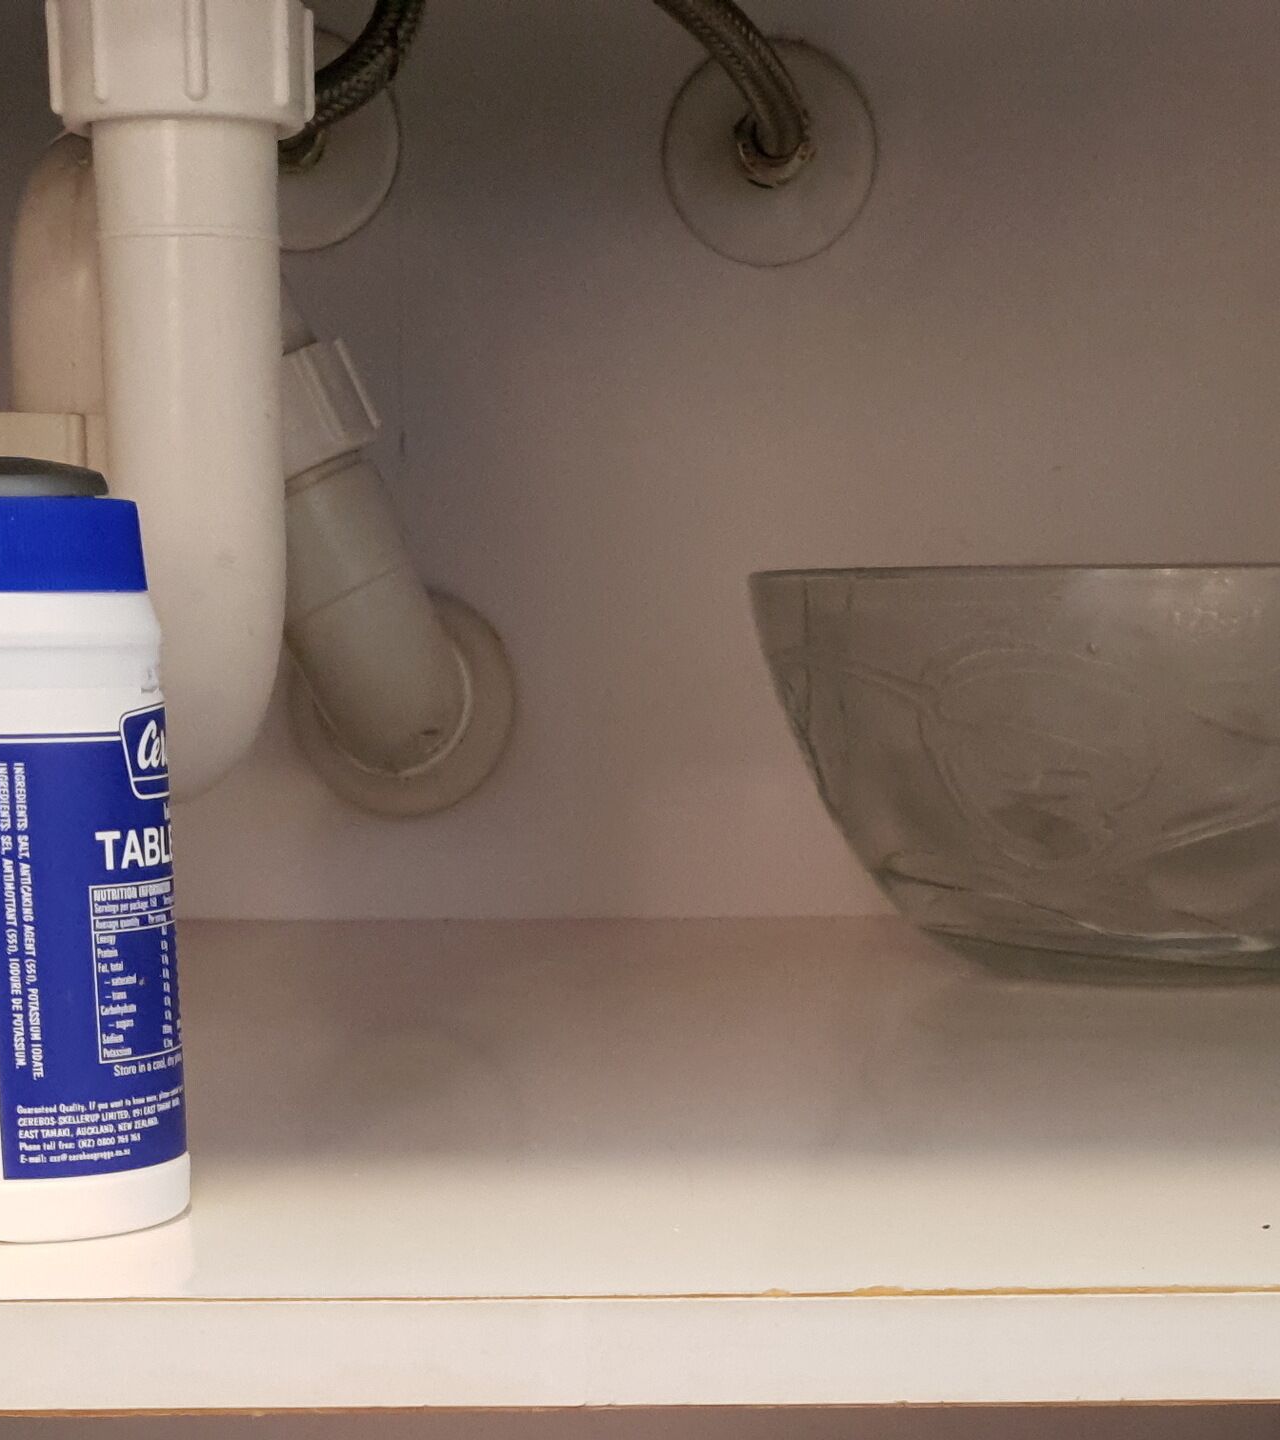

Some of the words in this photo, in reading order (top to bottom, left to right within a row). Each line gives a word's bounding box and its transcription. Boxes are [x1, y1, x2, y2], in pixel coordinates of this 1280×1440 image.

[19, 862, 35, 923] ANTICAKING
[93, 886, 138, 902] NUTRITION
[23, 924, 37, 957] AGENT
[8, 958, 23, 995] IODURE
[11, 998, 23, 1011] DE
[27, 987, 42, 1041] POTASSIUM
[113, 1063, 137, 1077] Store
[138, 1061, 147, 1073] in
[16, 1104, 57, 1115] Guaranteed
[18, 1128, 40, 1139] EAST
